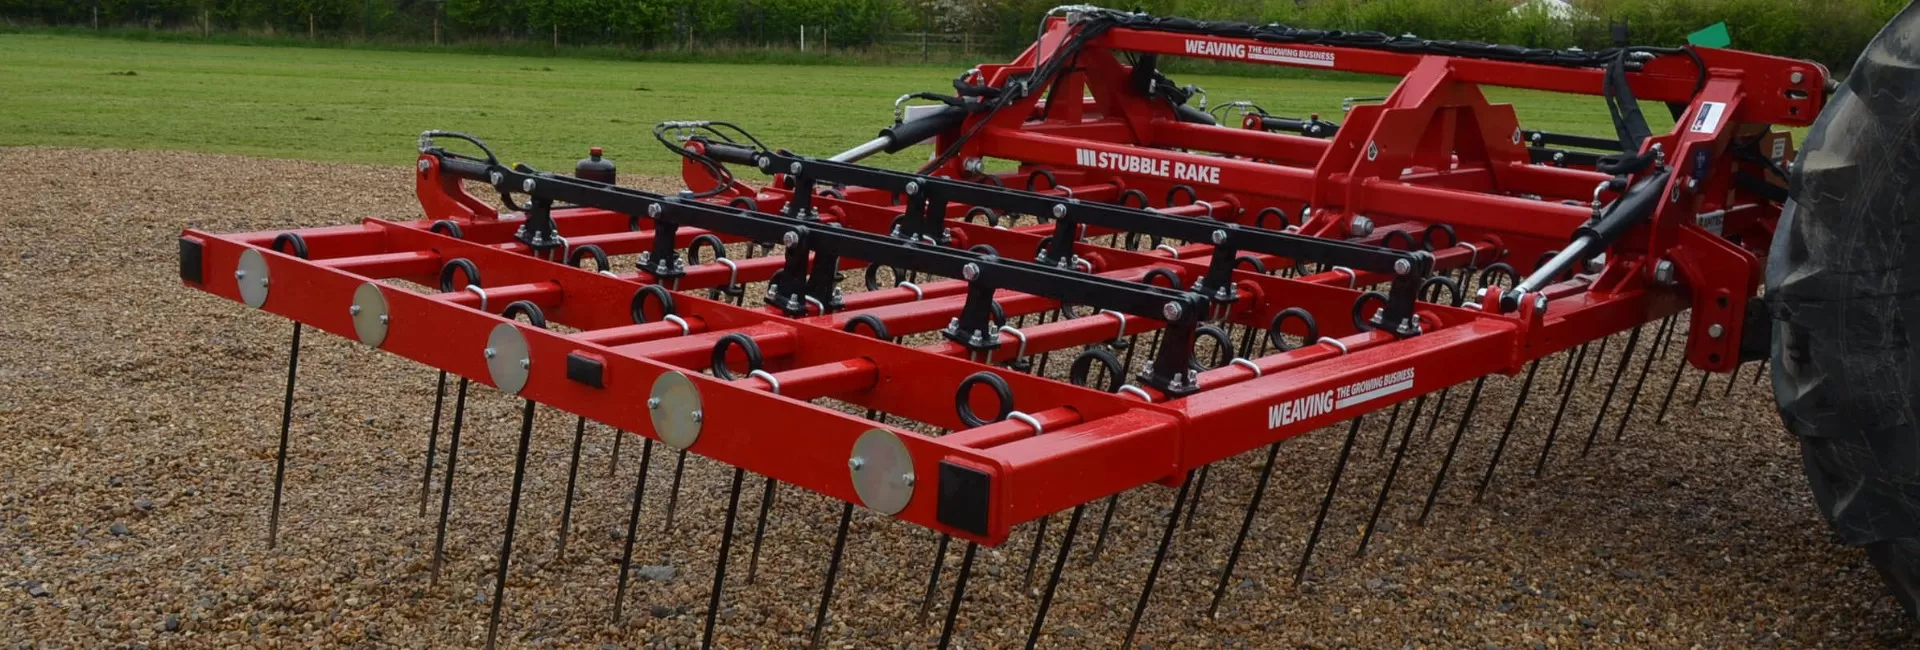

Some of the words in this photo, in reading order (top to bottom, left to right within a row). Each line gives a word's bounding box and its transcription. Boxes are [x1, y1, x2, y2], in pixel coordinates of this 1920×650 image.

[1185, 39, 1245, 58] WEAVING
[1248, 45, 1263, 54] THE
[1263, 46, 1298, 57] GROWING
[1299, 50, 1335, 61] BUSINESS
[1098, 151, 1170, 177] STUBBLE
[1174, 162, 1221, 184] RAKE
[1268, 390, 1333, 429] WEAVING
[1337, 385, 1350, 399] THE
[1351, 376, 1383, 395] GROWING
[1384, 367, 1415, 386] BUSINESS
